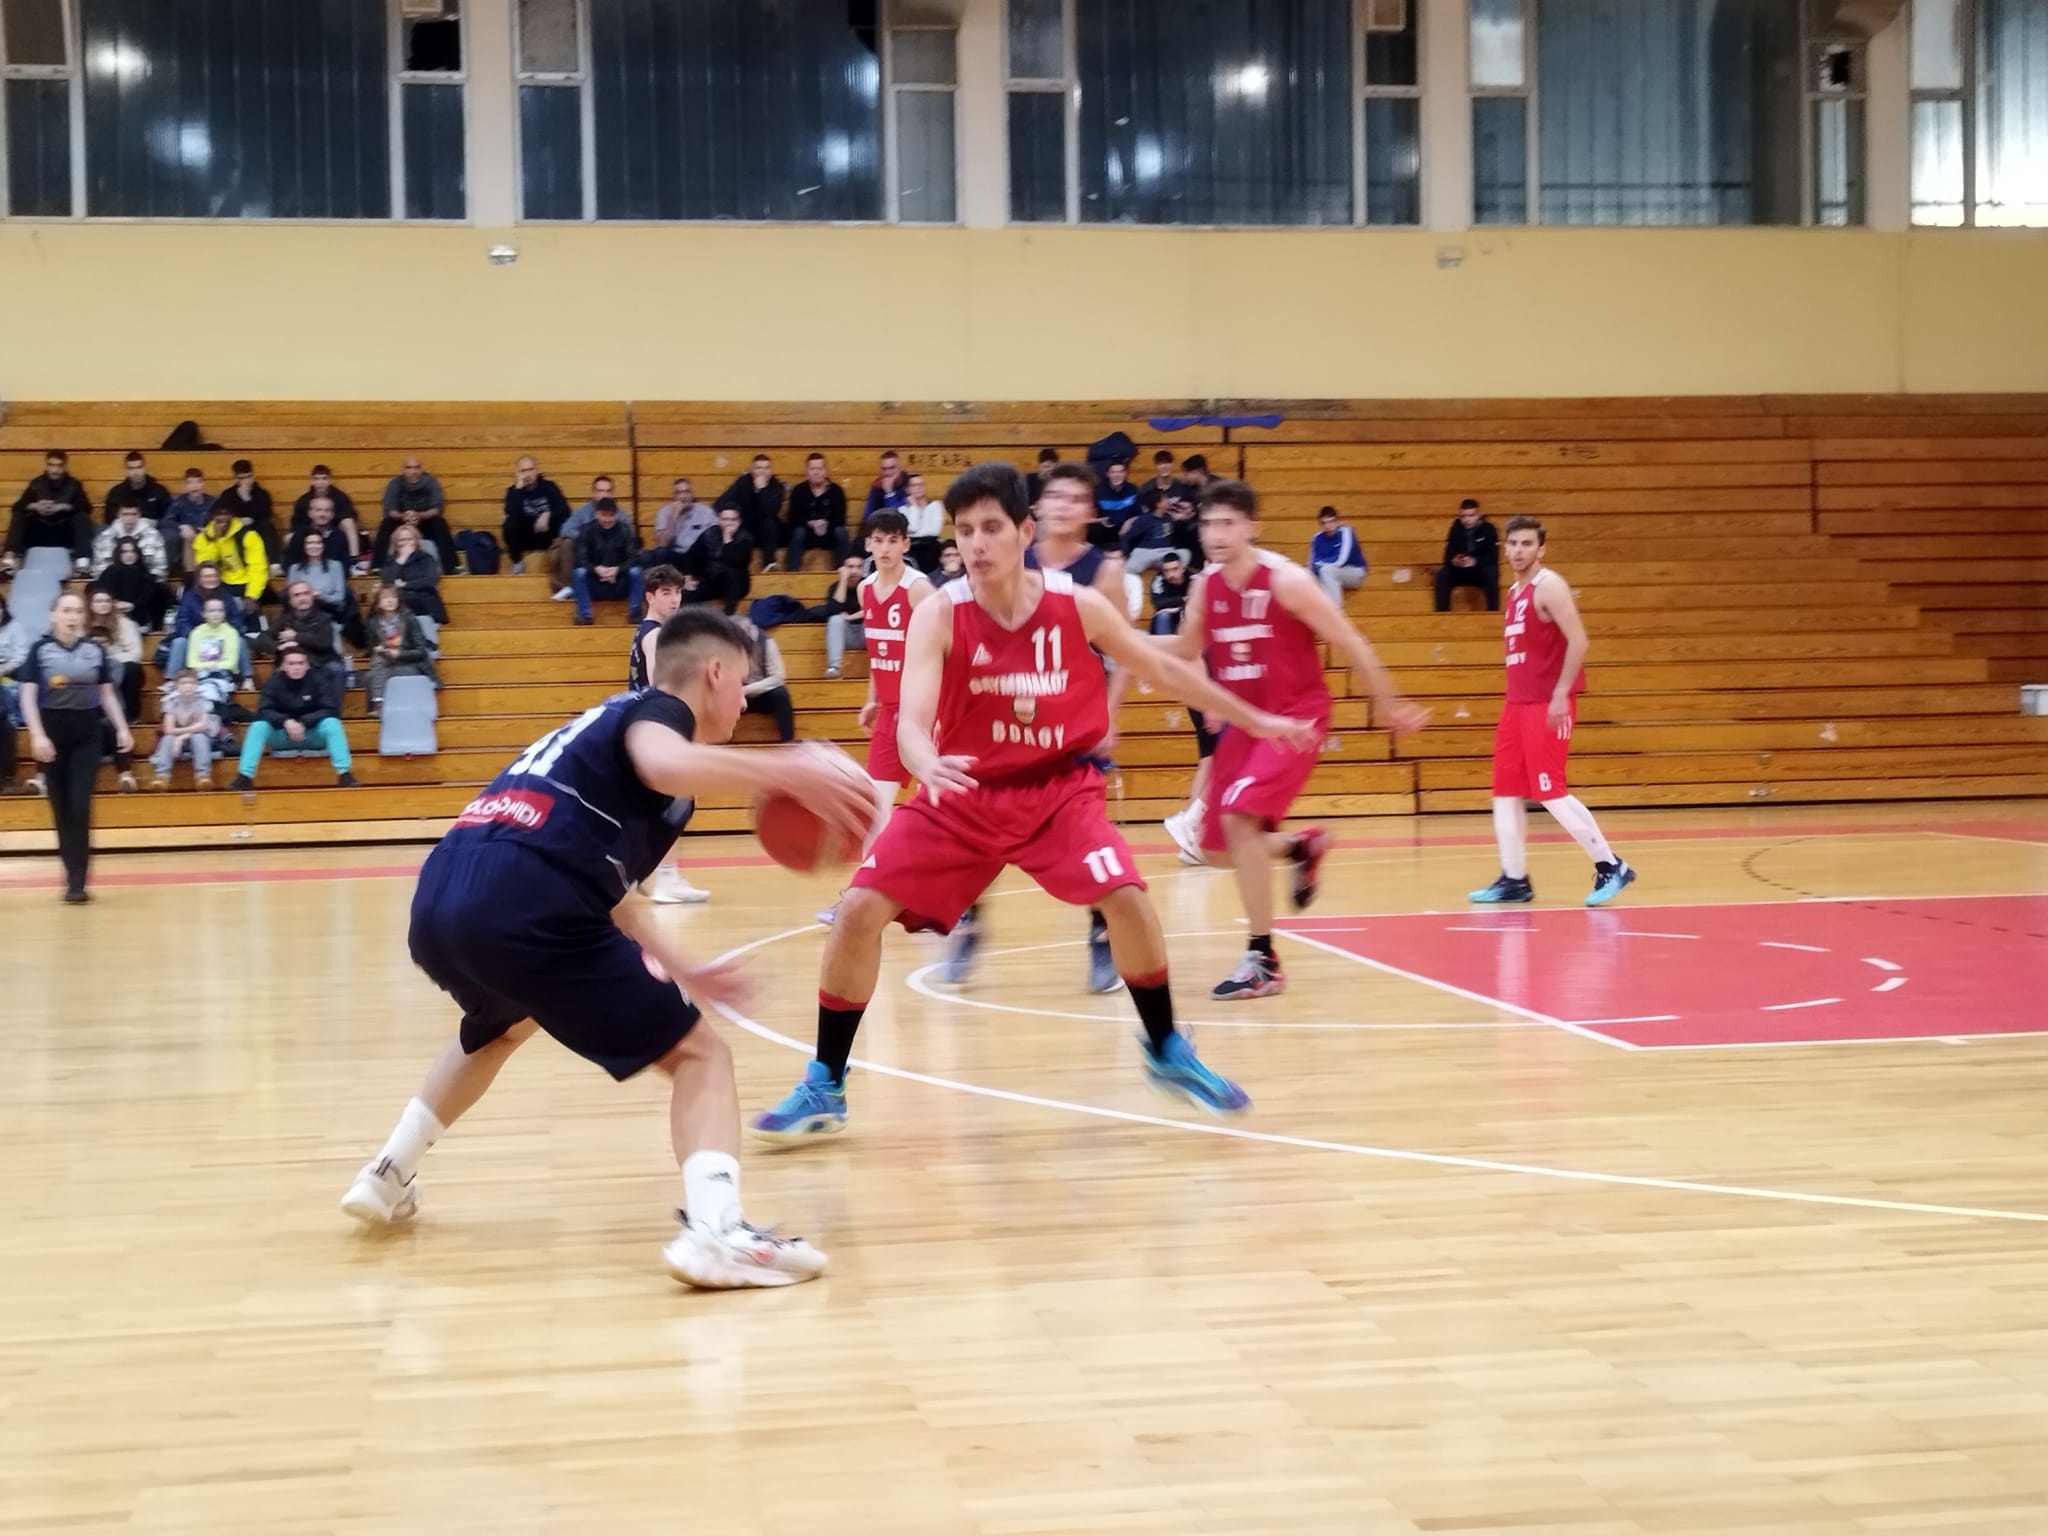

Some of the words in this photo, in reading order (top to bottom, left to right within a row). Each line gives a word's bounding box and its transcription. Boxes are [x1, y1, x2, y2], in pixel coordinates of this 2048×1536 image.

[888, 603, 901, 628] 6
[1031, 624, 1062, 673] 11
[1082, 846, 1124, 884] 11
